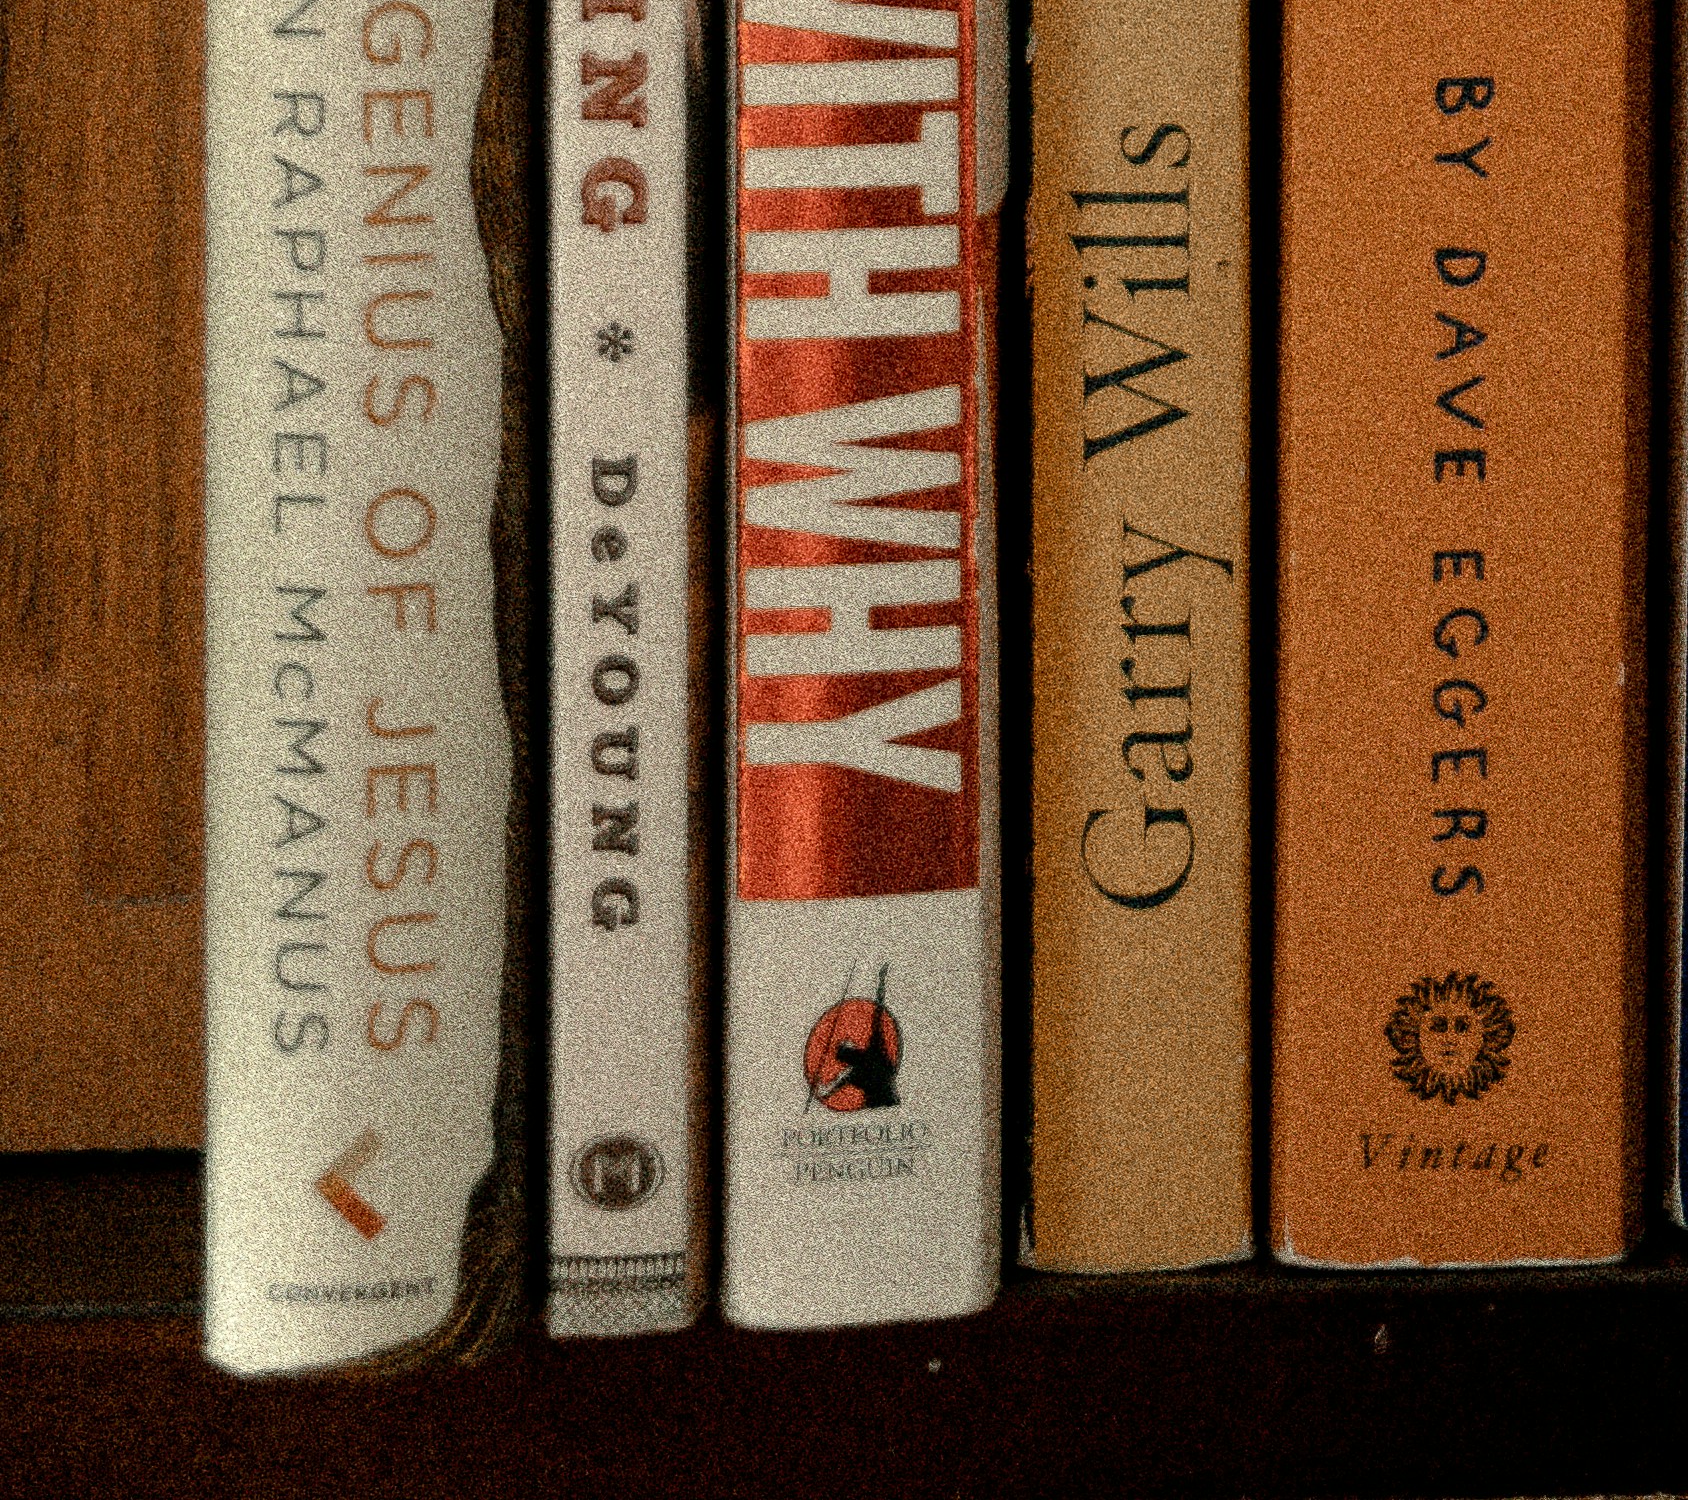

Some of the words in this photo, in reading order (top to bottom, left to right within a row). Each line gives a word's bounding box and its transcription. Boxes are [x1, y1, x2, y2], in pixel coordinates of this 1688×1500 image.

[358, 5, 438, 432] GENIUS
[1069, 120, 1191, 464] Wills
[1433, 75, 1496, 180] BY
[269, 89, 331, 537] RAPHAEL
[1432, 244, 1488, 484] DAVE
[360, 483, 440, 638] OF
[588, 457, 640, 934] DeYOUNG
[740, 390, 966, 797] WHY
[1080, 520, 1235, 913] Garry
[1429, 548, 1489, 899] EGGERS
[269, 583, 333, 1056] McMANUS
[361, 694, 442, 1058] JESUS
[781, 1121, 929, 1148] PORTFOLIO
[795, 1156, 915, 1184] PENGUIN
[1359, 1129, 1551, 1185] Vintage
